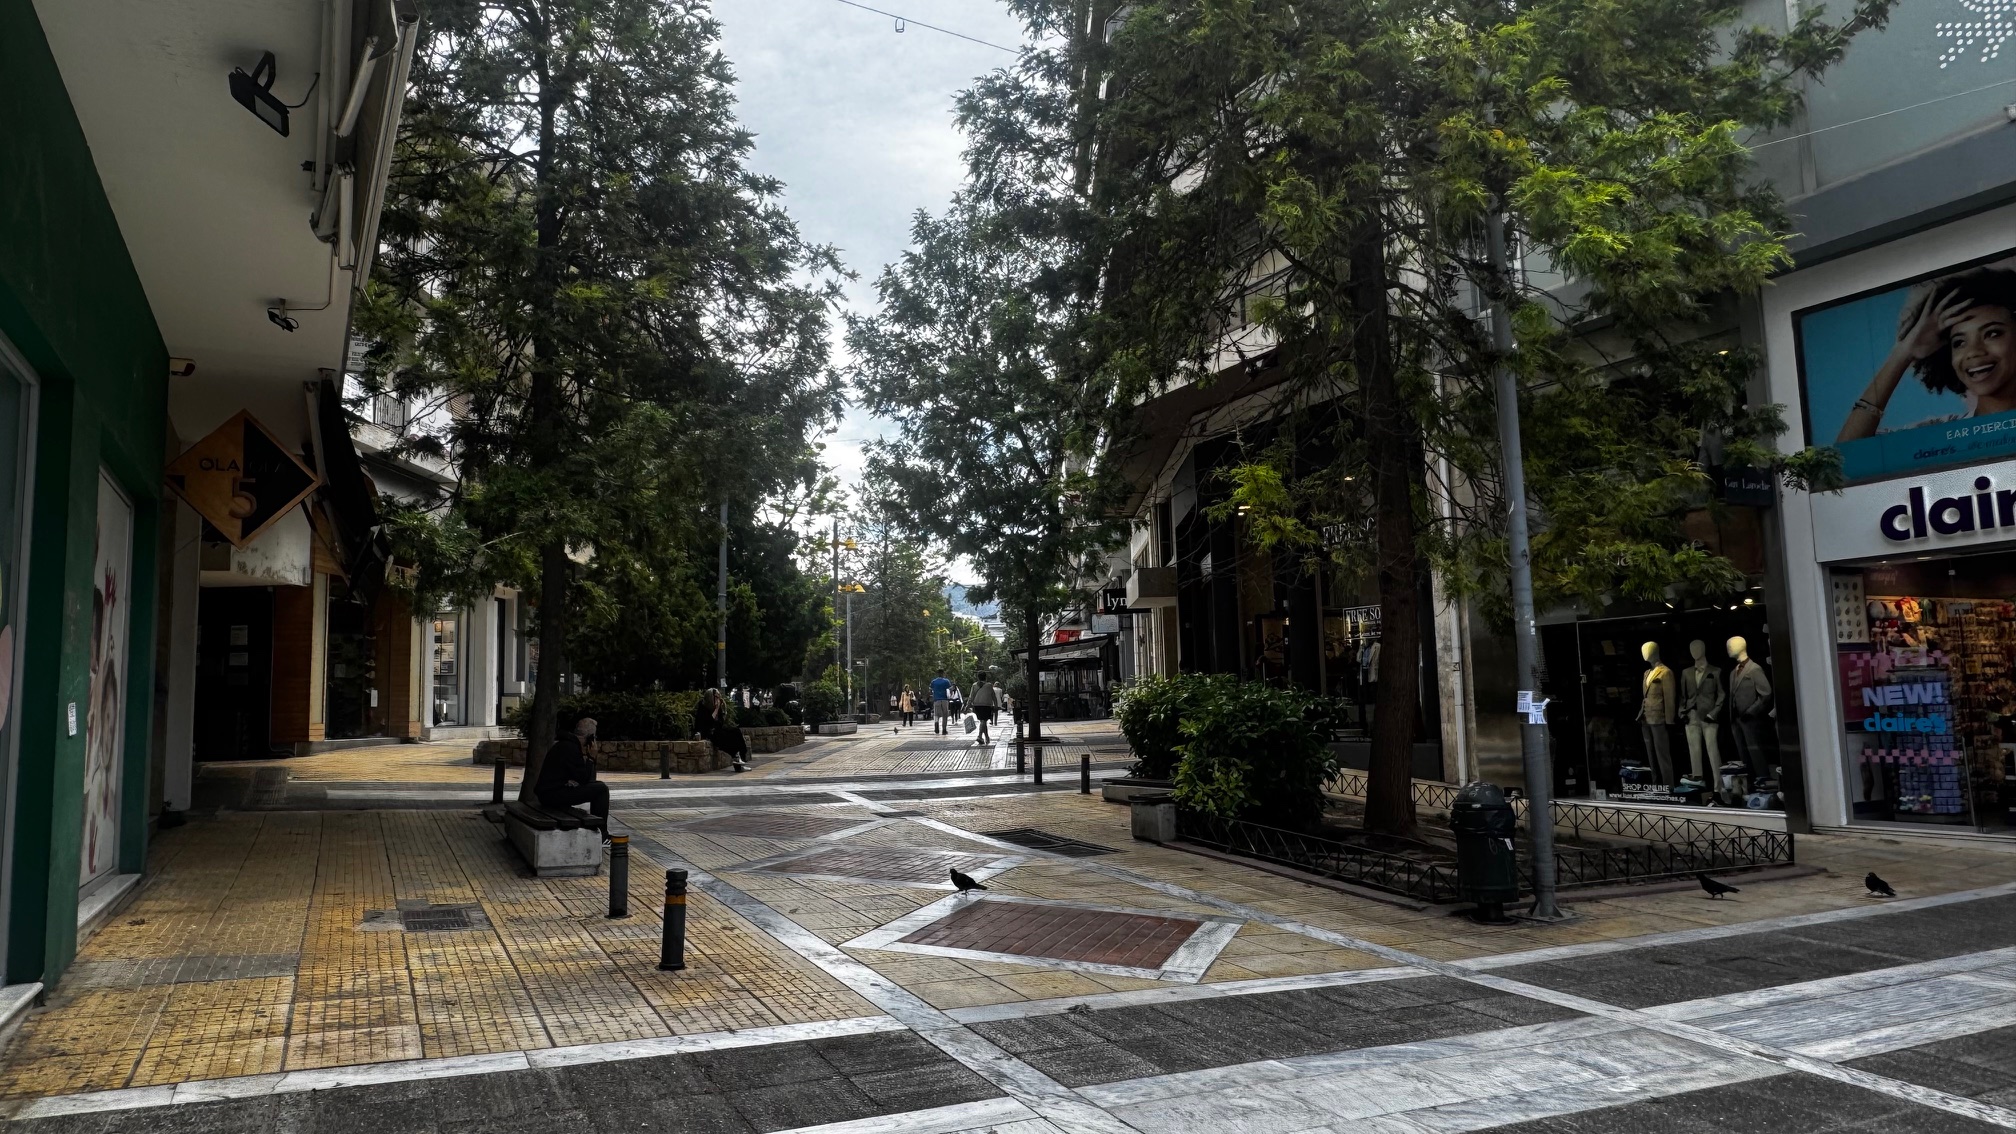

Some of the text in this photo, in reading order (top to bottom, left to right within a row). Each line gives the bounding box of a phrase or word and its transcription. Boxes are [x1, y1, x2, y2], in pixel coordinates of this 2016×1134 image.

[1946, 427, 1970, 440] EAR
[228, 476, 257, 519] 5
[1862, 682, 1945, 707] NEW!
[1622, 783, 1670, 792] SHOP ONLINE
